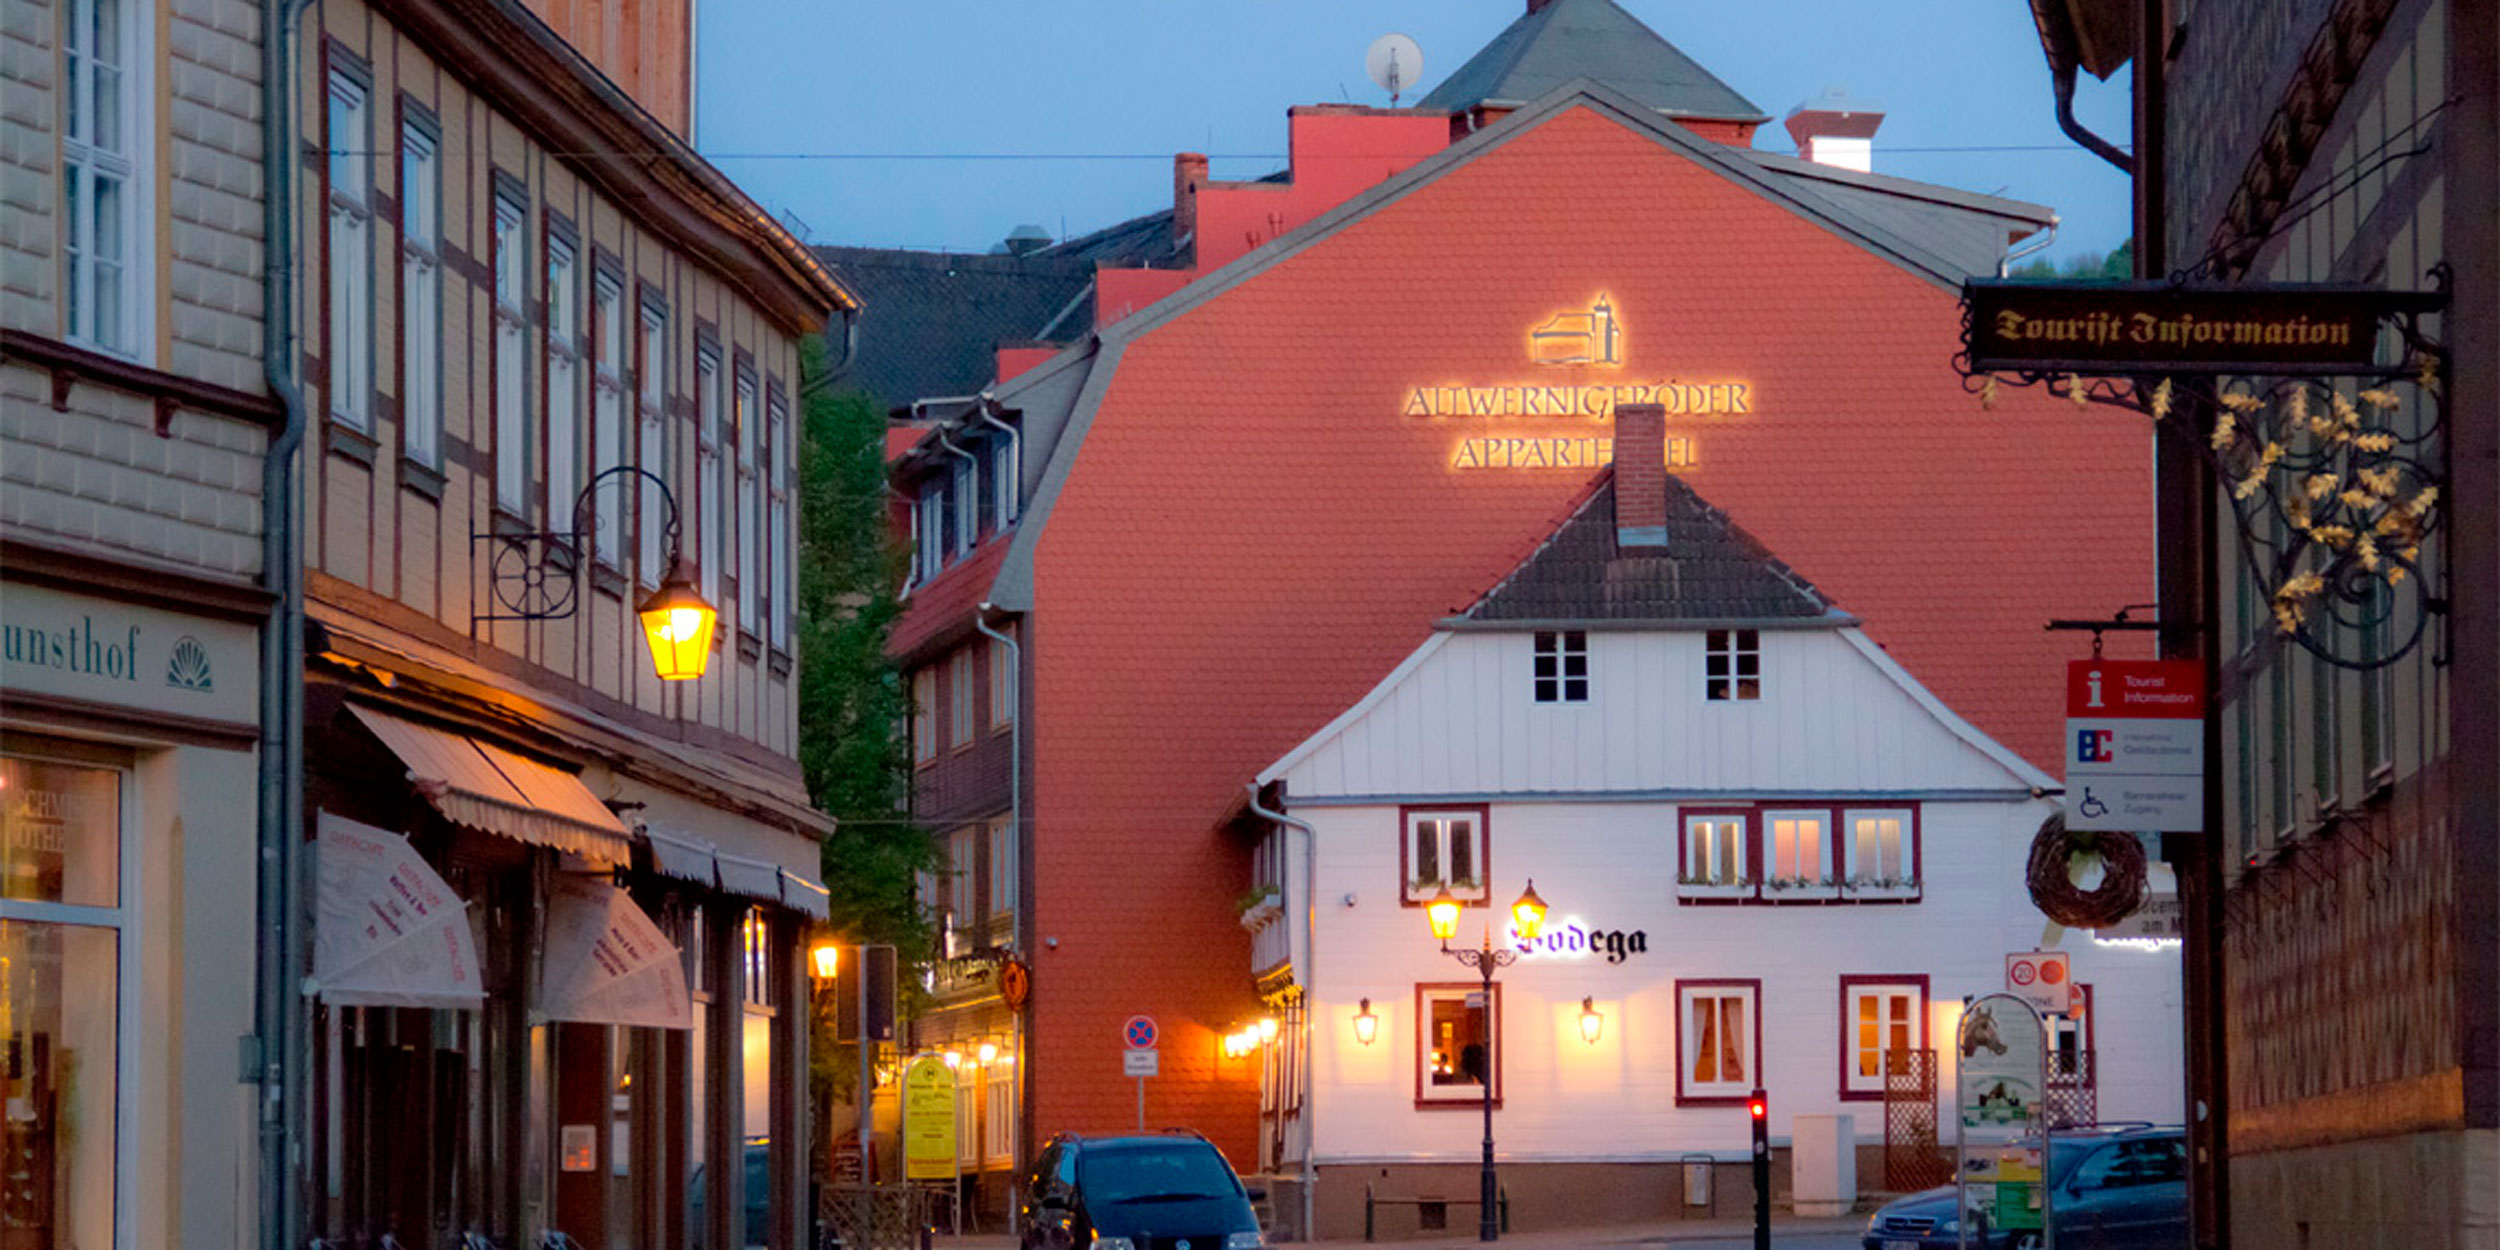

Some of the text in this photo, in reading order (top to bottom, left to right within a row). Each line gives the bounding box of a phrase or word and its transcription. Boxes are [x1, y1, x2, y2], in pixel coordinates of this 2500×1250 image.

[2129, 312, 2350, 348] Information
[1455, 437, 1697, 468] APPARTHEL
[2124, 675, 2165, 687] Tourist
[2124, 692, 2194, 703] Information
